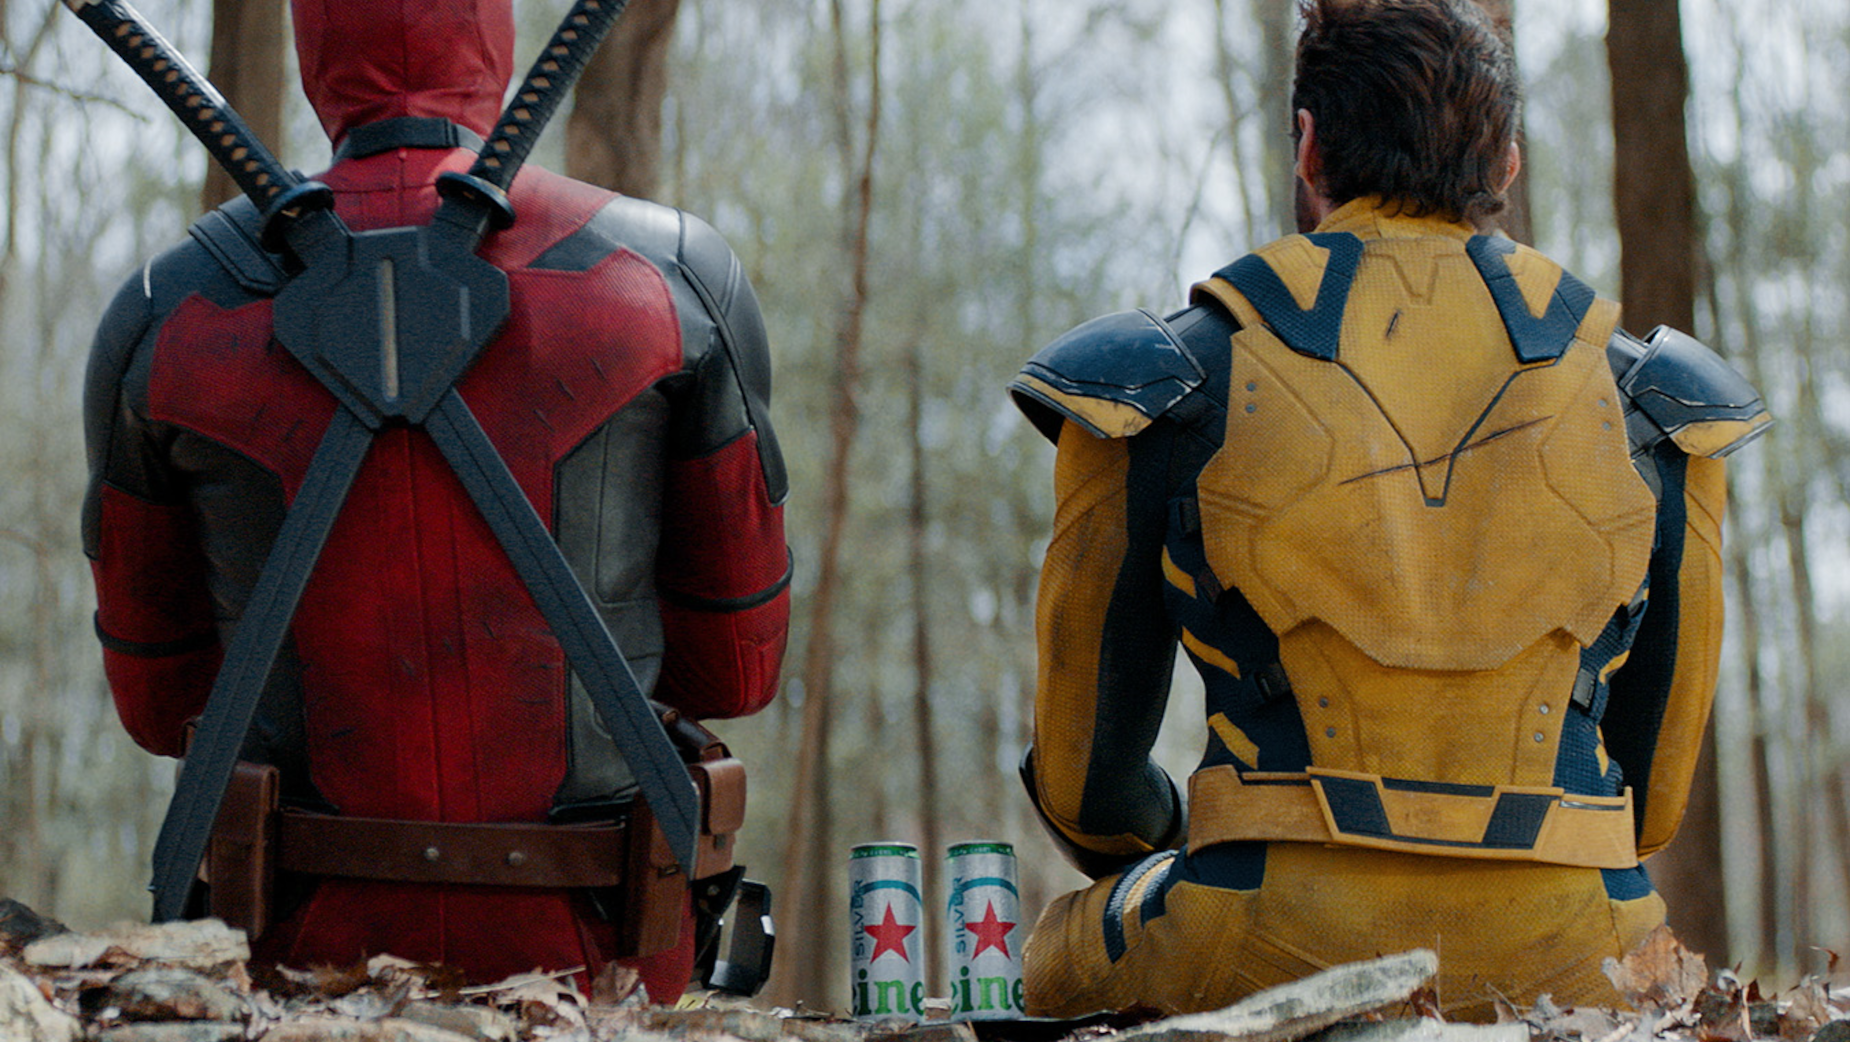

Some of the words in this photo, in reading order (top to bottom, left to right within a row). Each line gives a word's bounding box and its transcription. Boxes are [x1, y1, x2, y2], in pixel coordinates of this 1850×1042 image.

[853, 879, 865, 957] SILVER
[953, 876, 967, 954] SILVER
[852, 968, 925, 1016] ine
